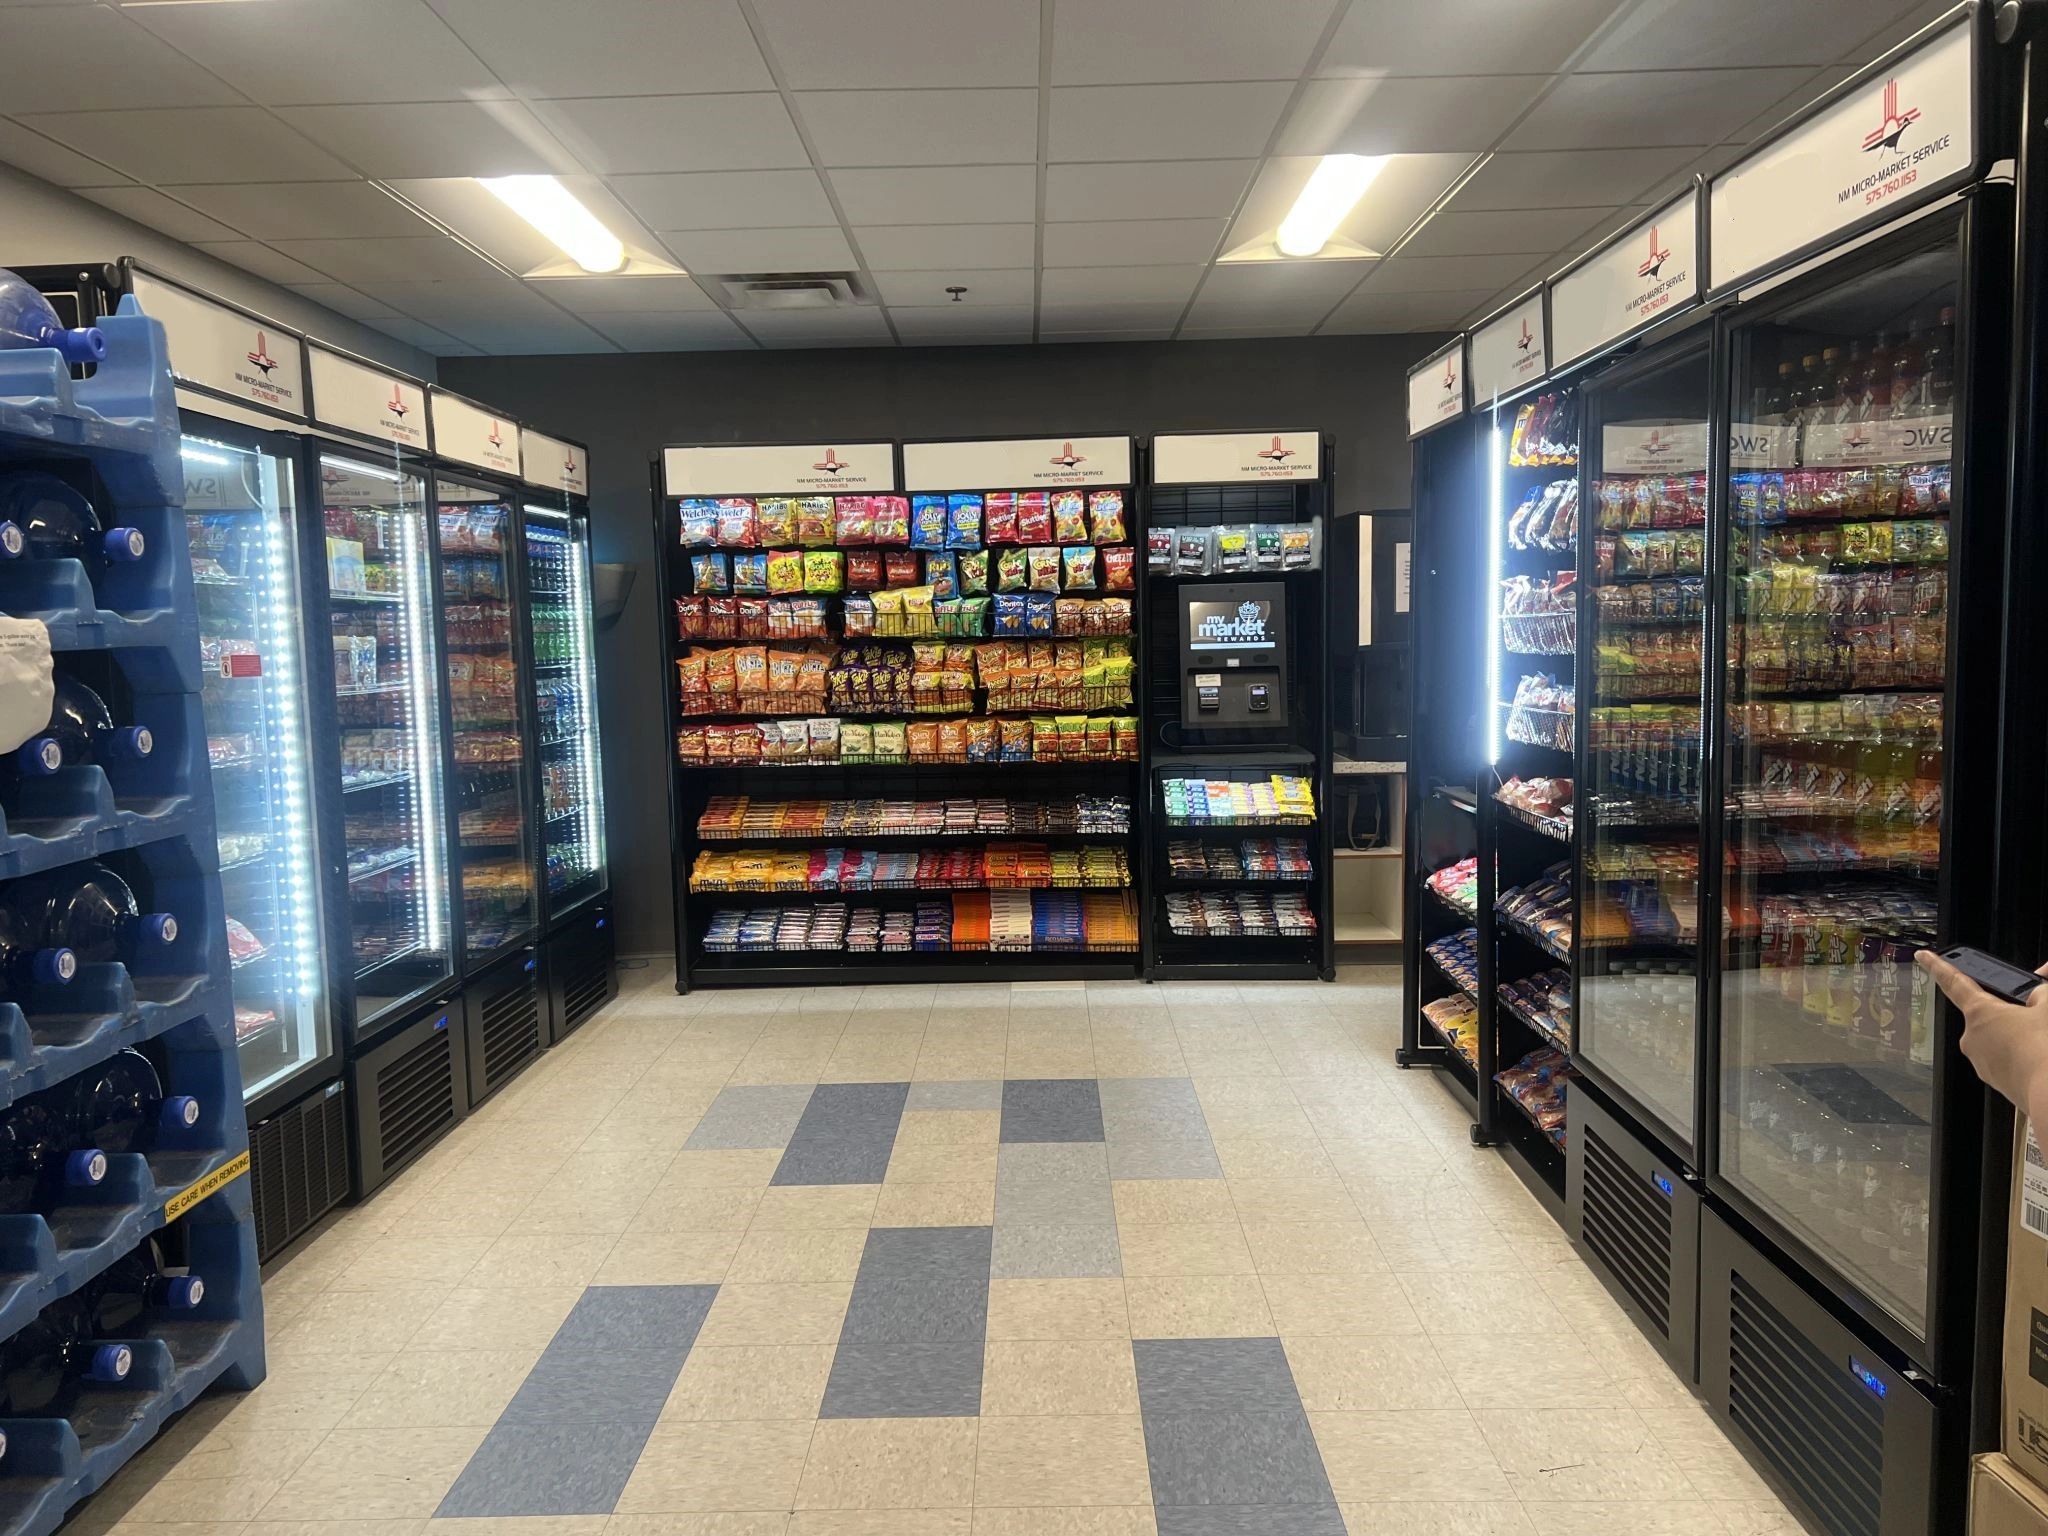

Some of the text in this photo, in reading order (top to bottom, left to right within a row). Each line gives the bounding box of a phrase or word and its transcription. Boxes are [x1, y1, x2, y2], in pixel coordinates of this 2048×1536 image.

[1838, 134, 1950, 204] NM MICRO-MARKET SERVICE
[1865, 169, 1917, 205] 575.760.1153
[1632, 283, 1665, 309] MICRO-MARKET
[1665, 270, 1686, 290] SERVICE
[243, 375, 275, 391] MICRO-MARKET
[275, 386, 293, 398] SERVICE
[921, 512, 941, 521] JOLLY
[957, 511, 978, 521] JOLLY
[679, 605, 702, 614] Doritos
[999, 600, 1024, 609] Doritos
[1027, 602, 1052, 611] Doritos
[740, 606, 764, 615] Doritos
[1206, 615, 1226, 625] my
[1198, 617, 1265, 637] market
[165, 1155, 249, 1217] USE CARE WHEN REMOVING
